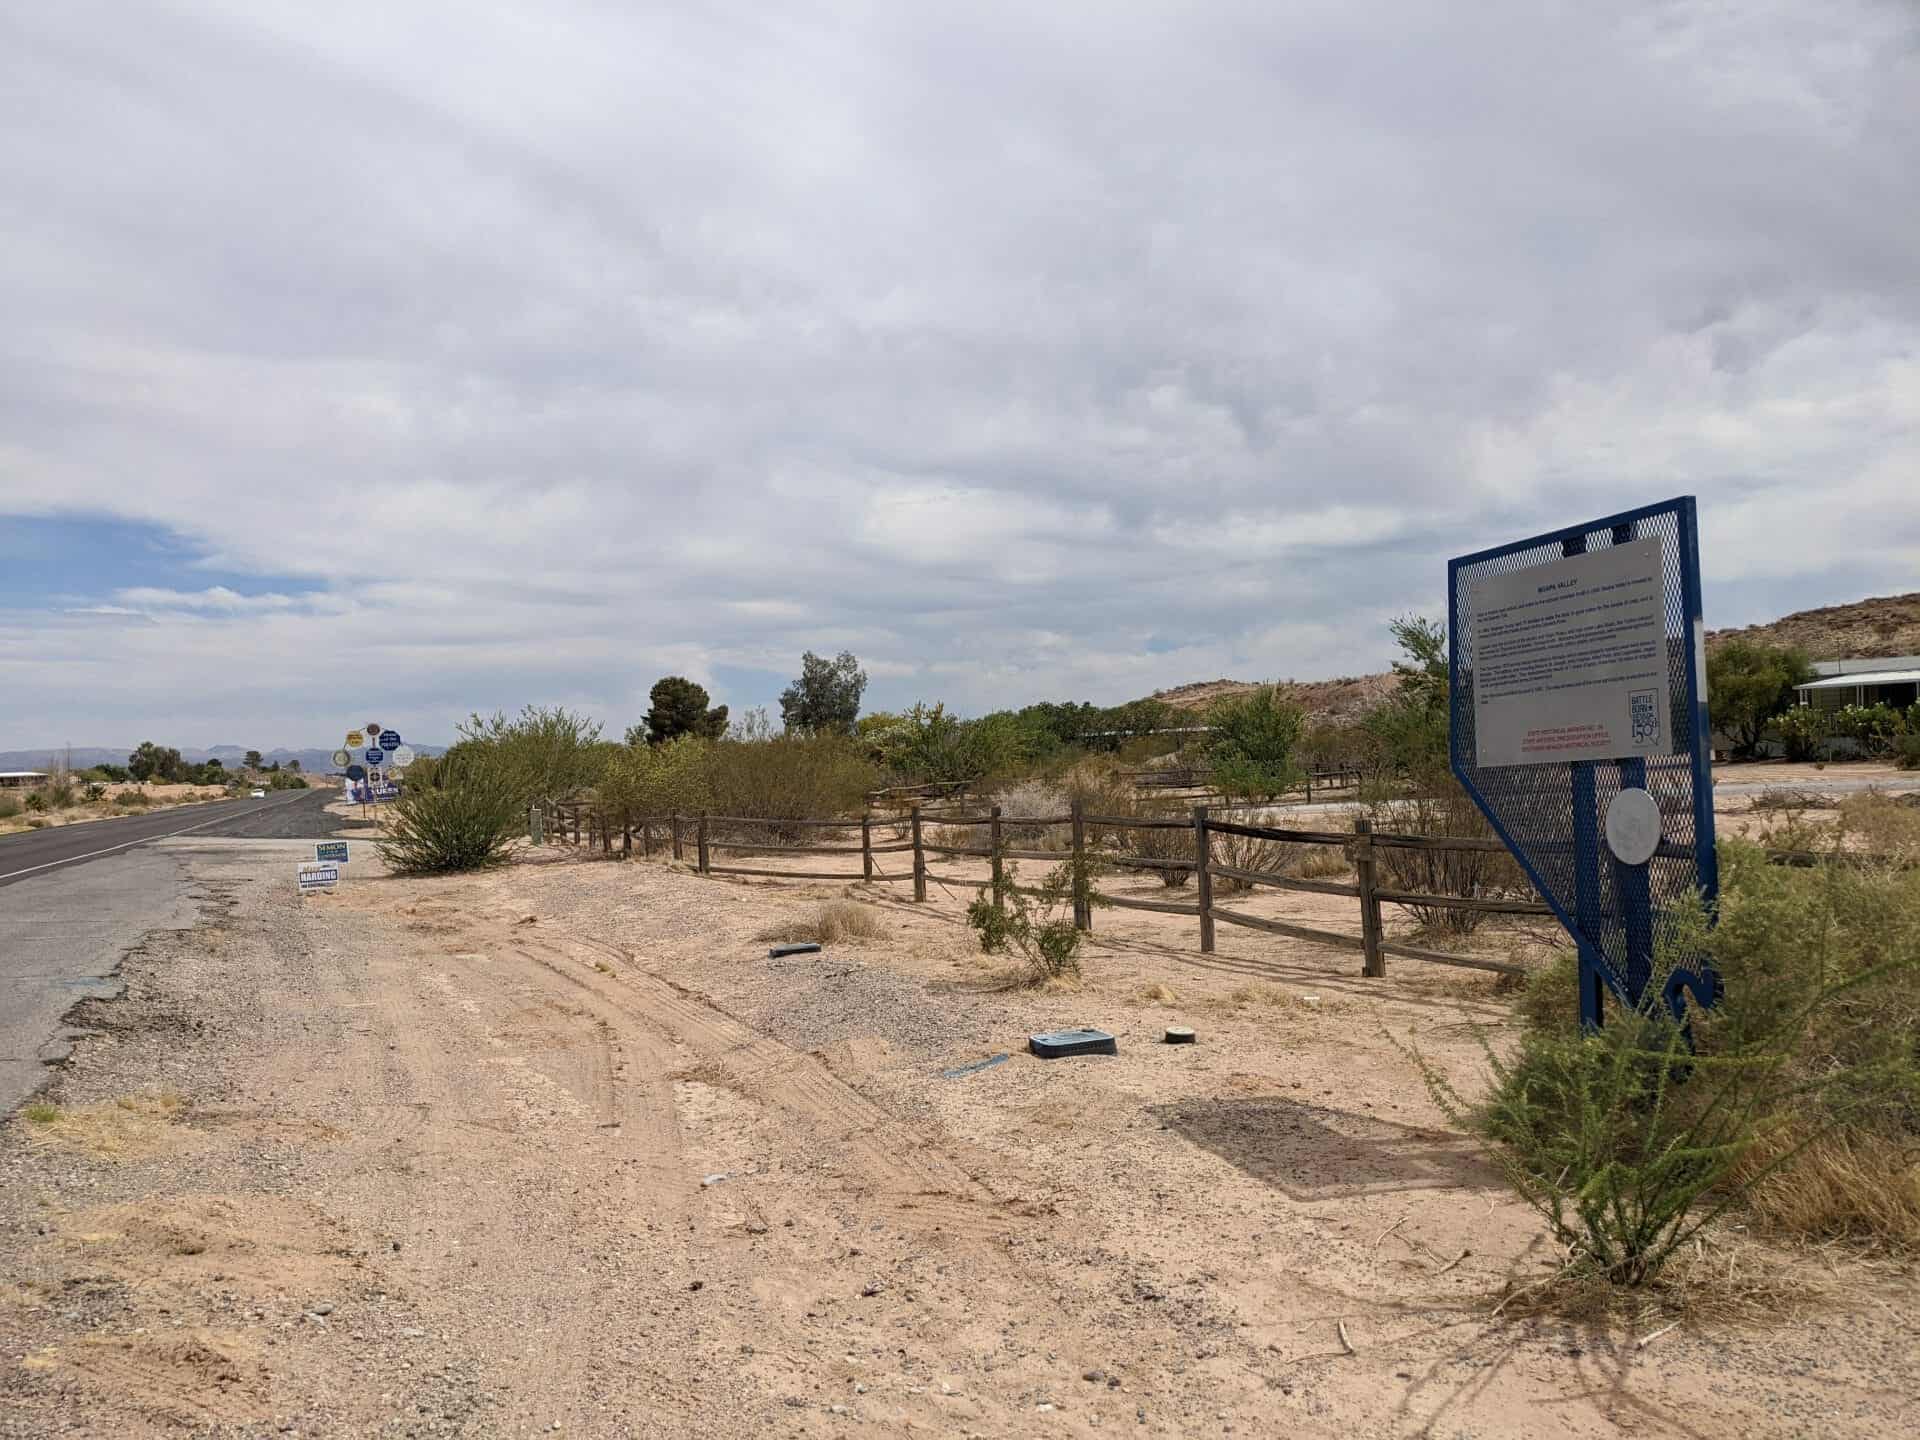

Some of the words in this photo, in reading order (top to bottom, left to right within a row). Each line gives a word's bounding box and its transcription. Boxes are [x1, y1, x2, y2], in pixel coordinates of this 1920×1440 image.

[1557, 577, 1577, 589] VALLEY
[1631, 694, 1653, 704] BATTLE
[300, 871, 337, 882] HARDING
